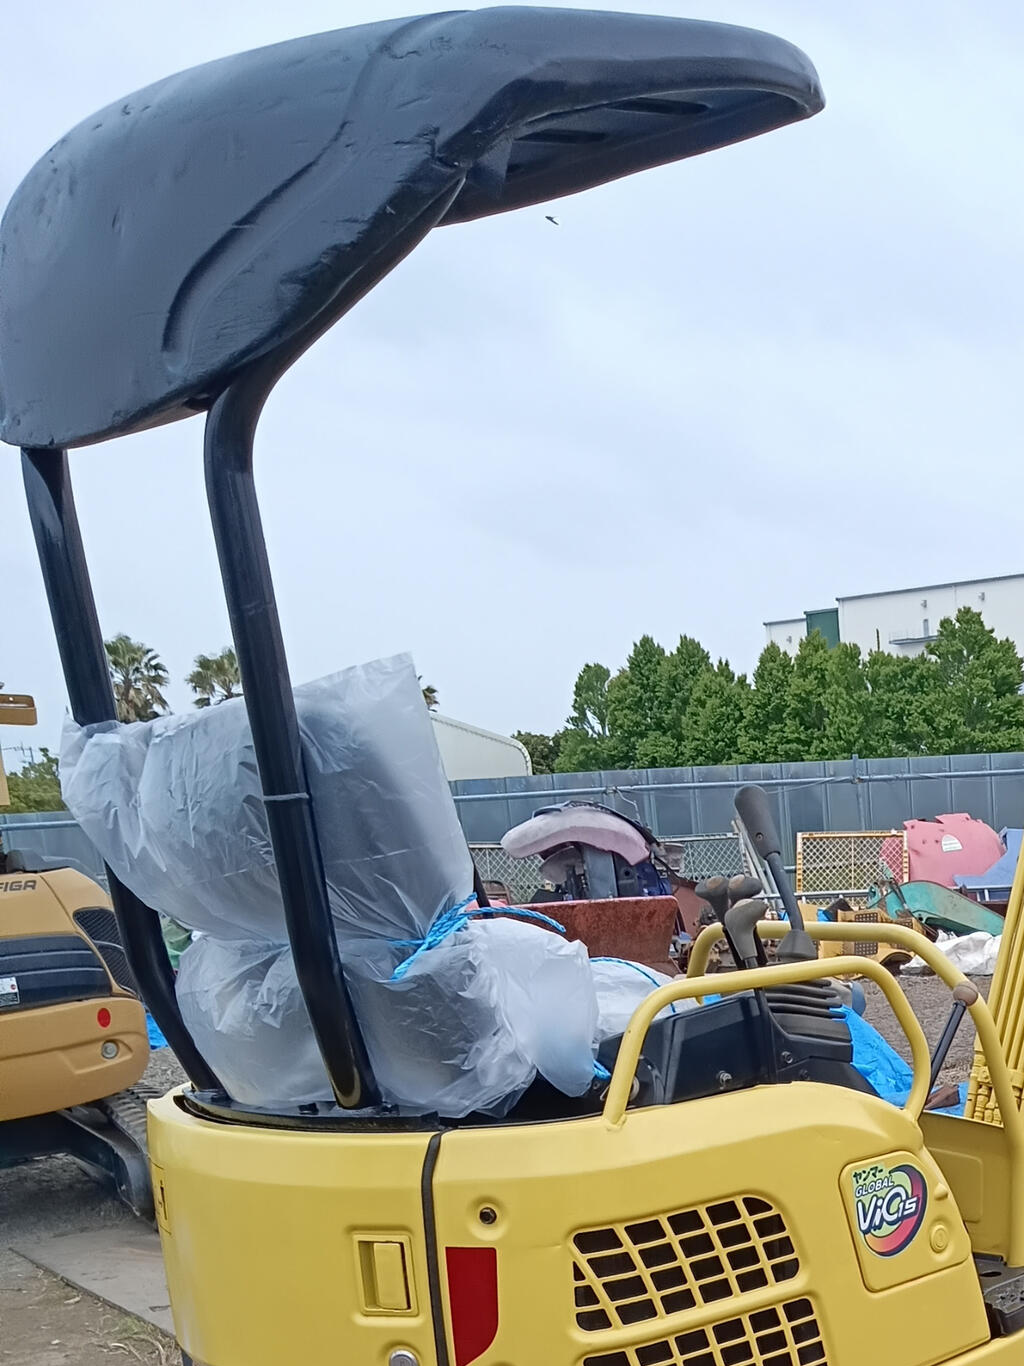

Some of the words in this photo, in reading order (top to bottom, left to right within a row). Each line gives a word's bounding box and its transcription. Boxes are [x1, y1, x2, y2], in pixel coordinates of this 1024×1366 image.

[853, 1166, 884, 1184] ヤンマー
[855, 1176, 895, 1197] GLOBAL
